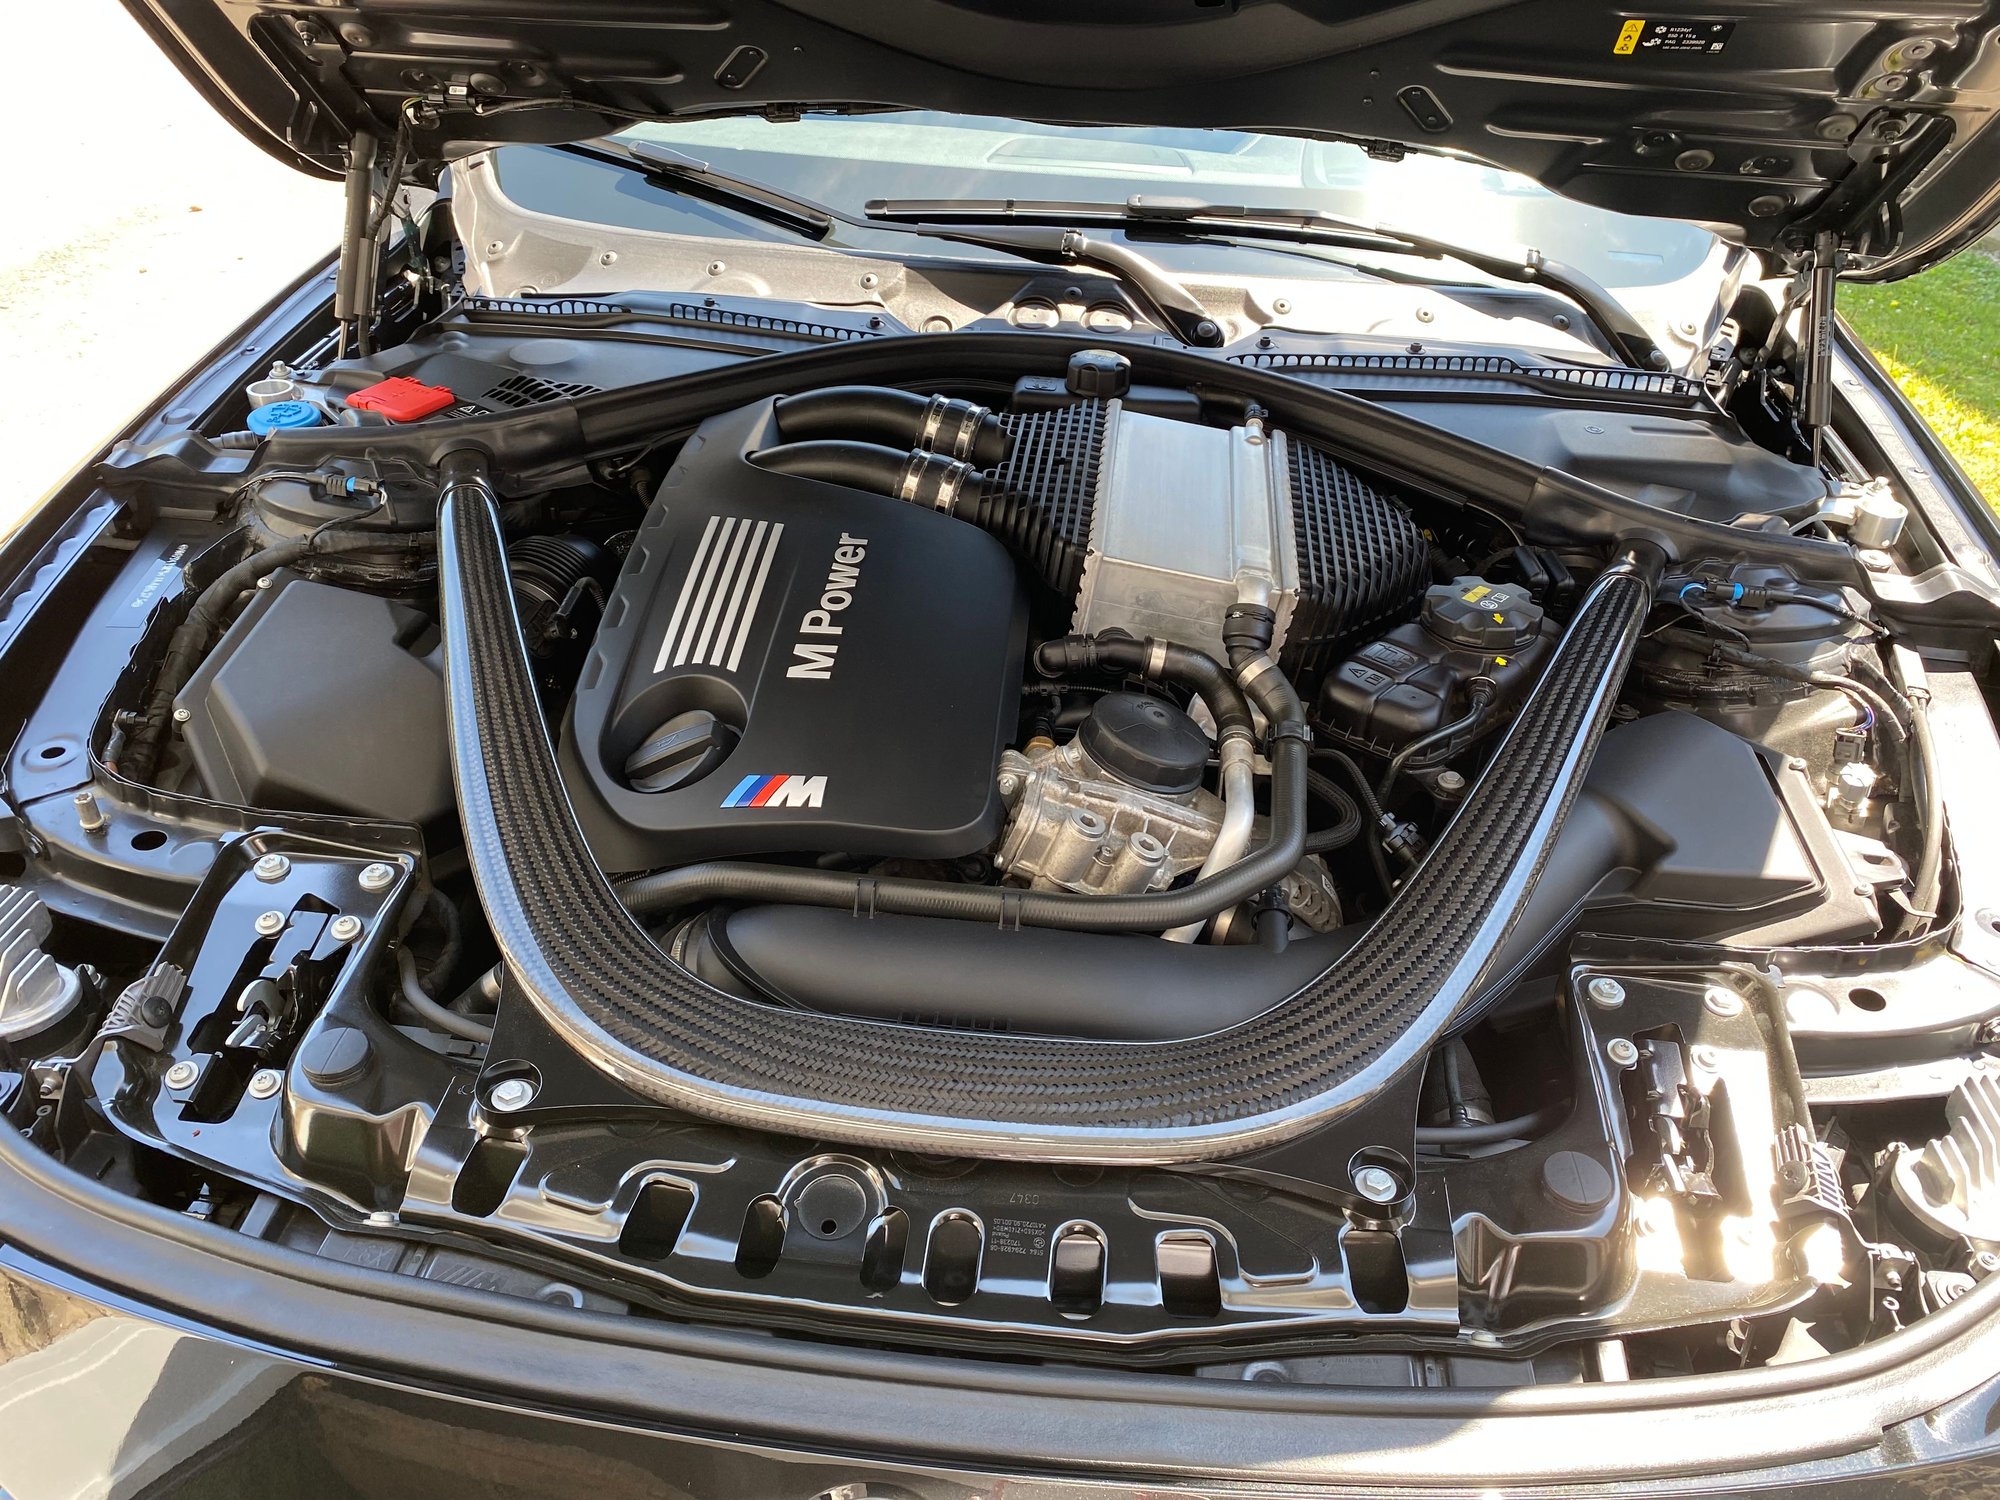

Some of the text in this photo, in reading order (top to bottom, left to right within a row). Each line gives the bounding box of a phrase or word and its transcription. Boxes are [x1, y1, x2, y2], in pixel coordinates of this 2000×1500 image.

[786, 532, 869, 680] M Power
[764, 776, 828, 808] M
